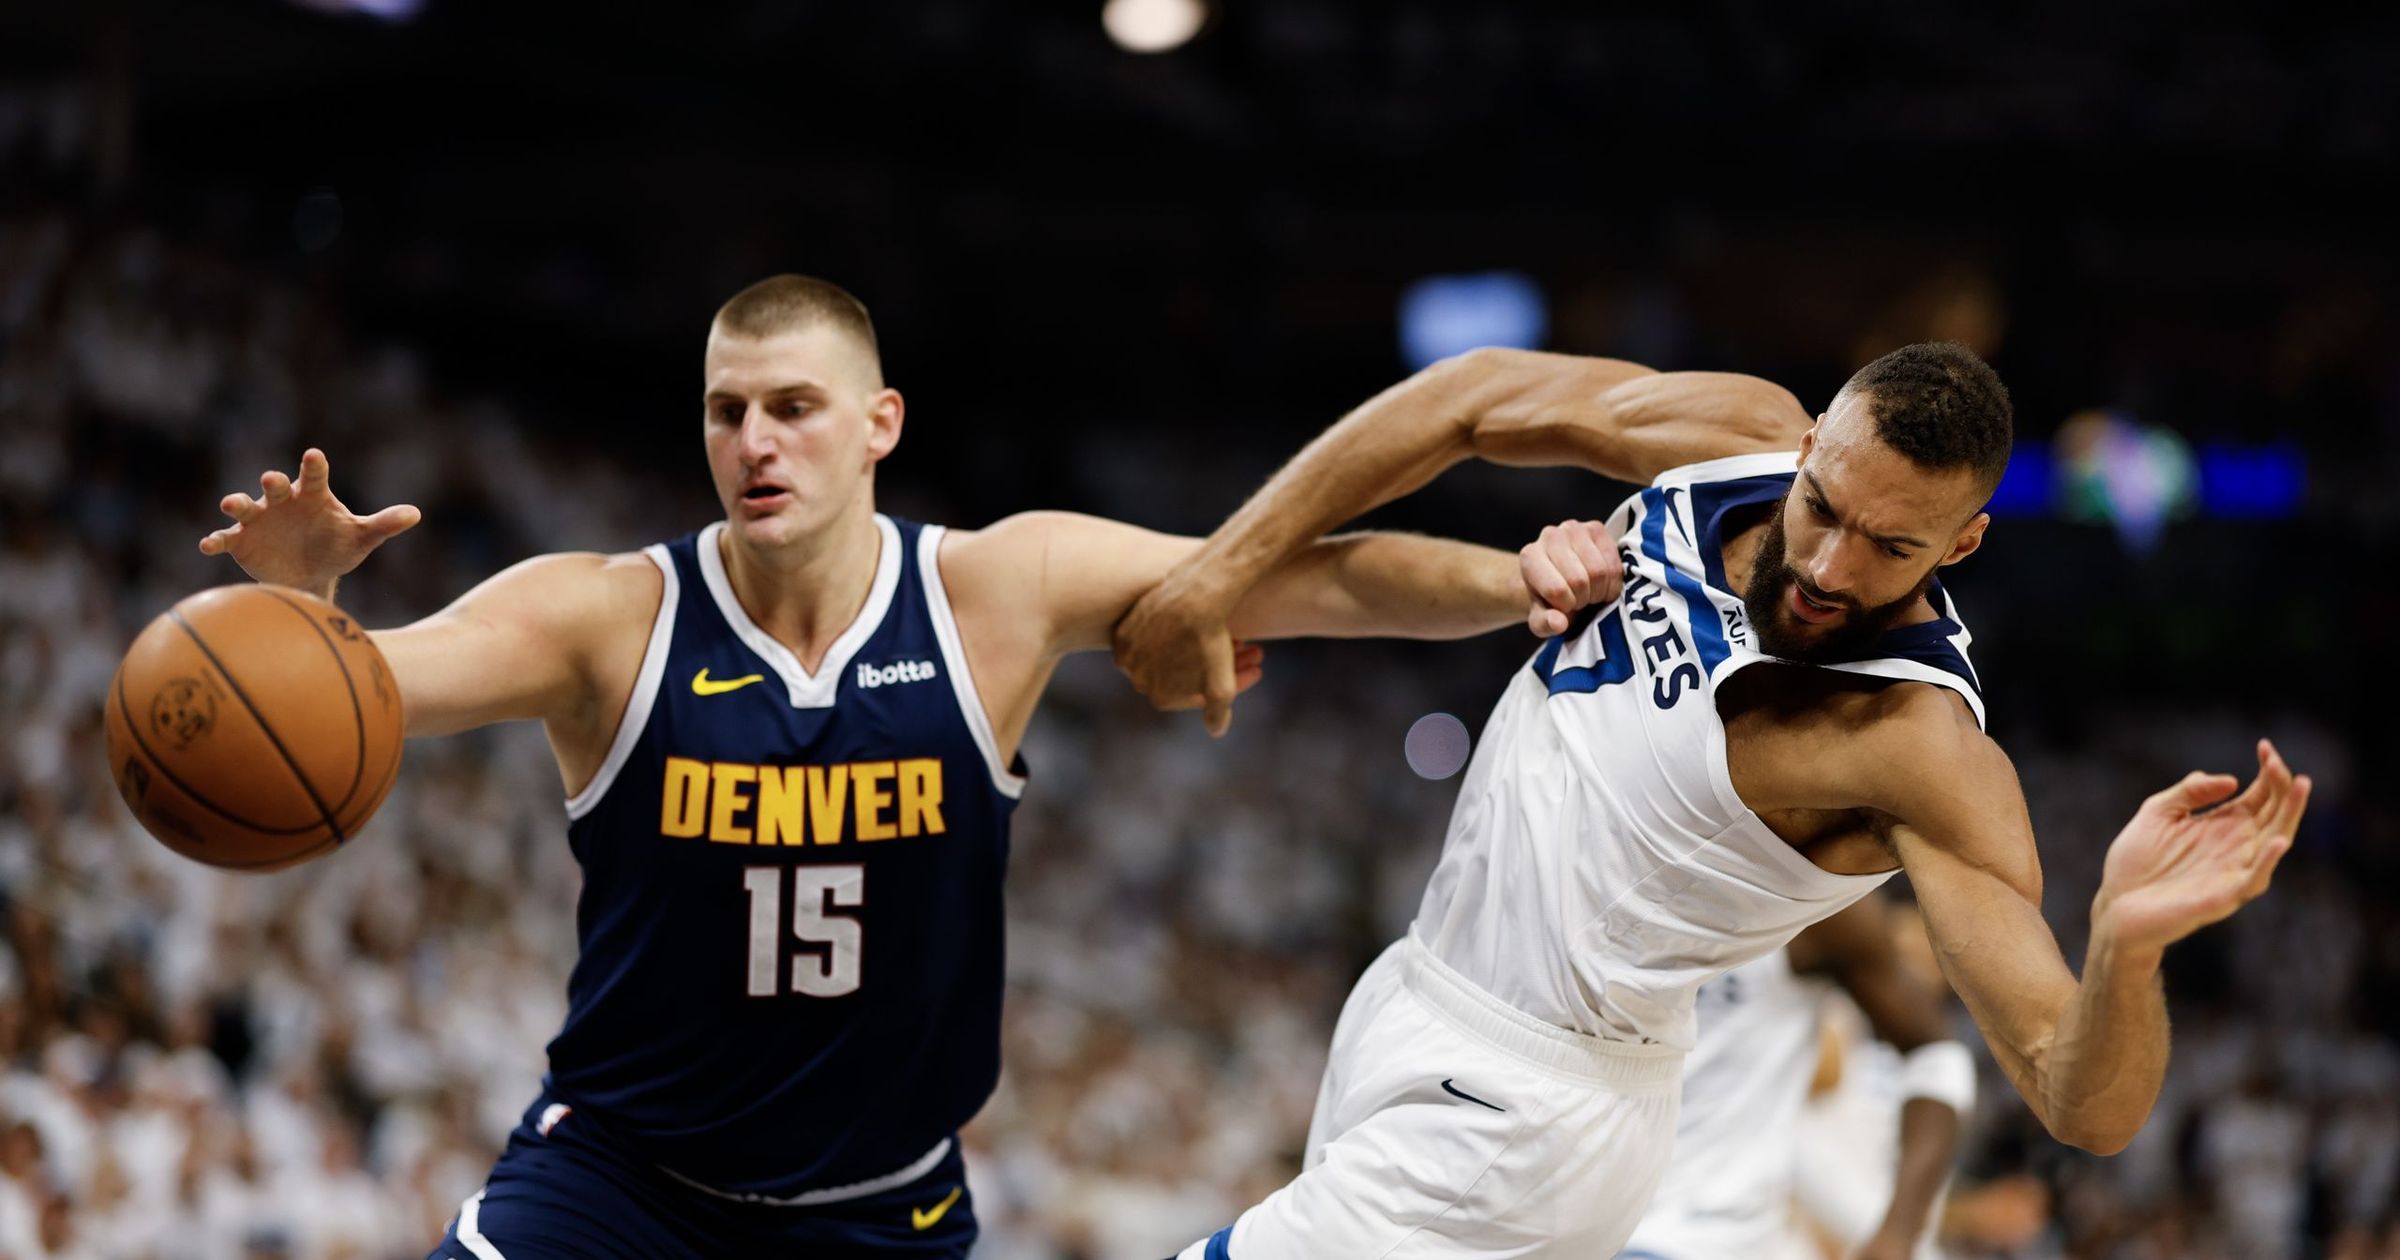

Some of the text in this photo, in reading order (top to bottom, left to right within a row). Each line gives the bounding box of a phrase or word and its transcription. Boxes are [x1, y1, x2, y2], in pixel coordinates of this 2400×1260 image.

[857, 660, 936, 689] ibotta
[660, 756, 946, 847] DENVER
[743, 865, 866, 998] 15
